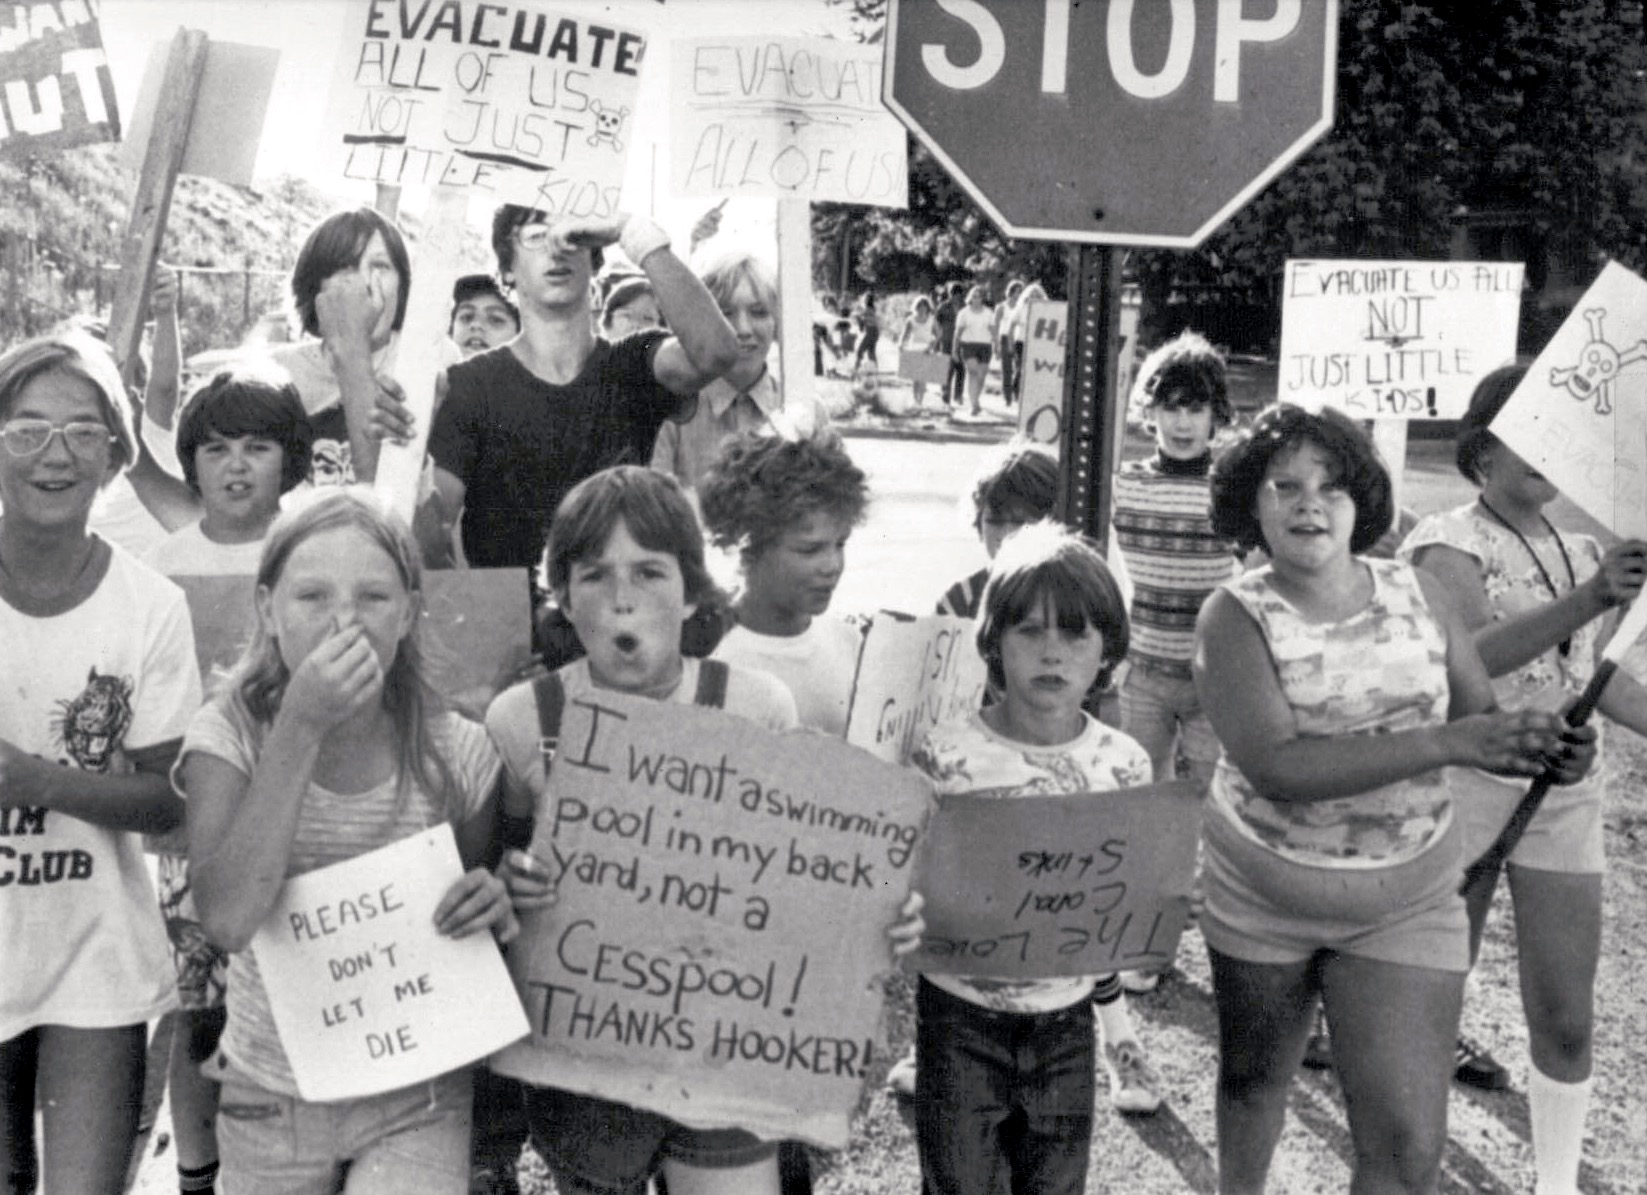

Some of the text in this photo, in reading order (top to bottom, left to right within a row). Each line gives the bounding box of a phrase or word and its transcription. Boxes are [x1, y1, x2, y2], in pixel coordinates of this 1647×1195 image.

[365, 0, 644, 76] EVACUATE
[920, 0, 1301, 102] STOP
[355, 41, 590, 113] ALL OF US
[358, 91, 584, 162] NOT JUST
[1367, 295, 1436, 340] NOT
[1288, 348, 1475, 391] JUST LITTLE
[564, 699, 628, 773] I
[627, 745, 738, 802] want
[0, 845, 94, 887] CLUB
[552, 798, 875, 890] pool in my back
[289, 883, 405, 944] PLEASE
[550, 843, 771, 931] yard, not a
[328, 942, 400, 983] DON'T
[1058, 912, 1168, 961] The
[322, 974, 434, 1028] LET ME
[527, 980, 696, 1052] THANKS
[366, 1027, 419, 1061] DIE
